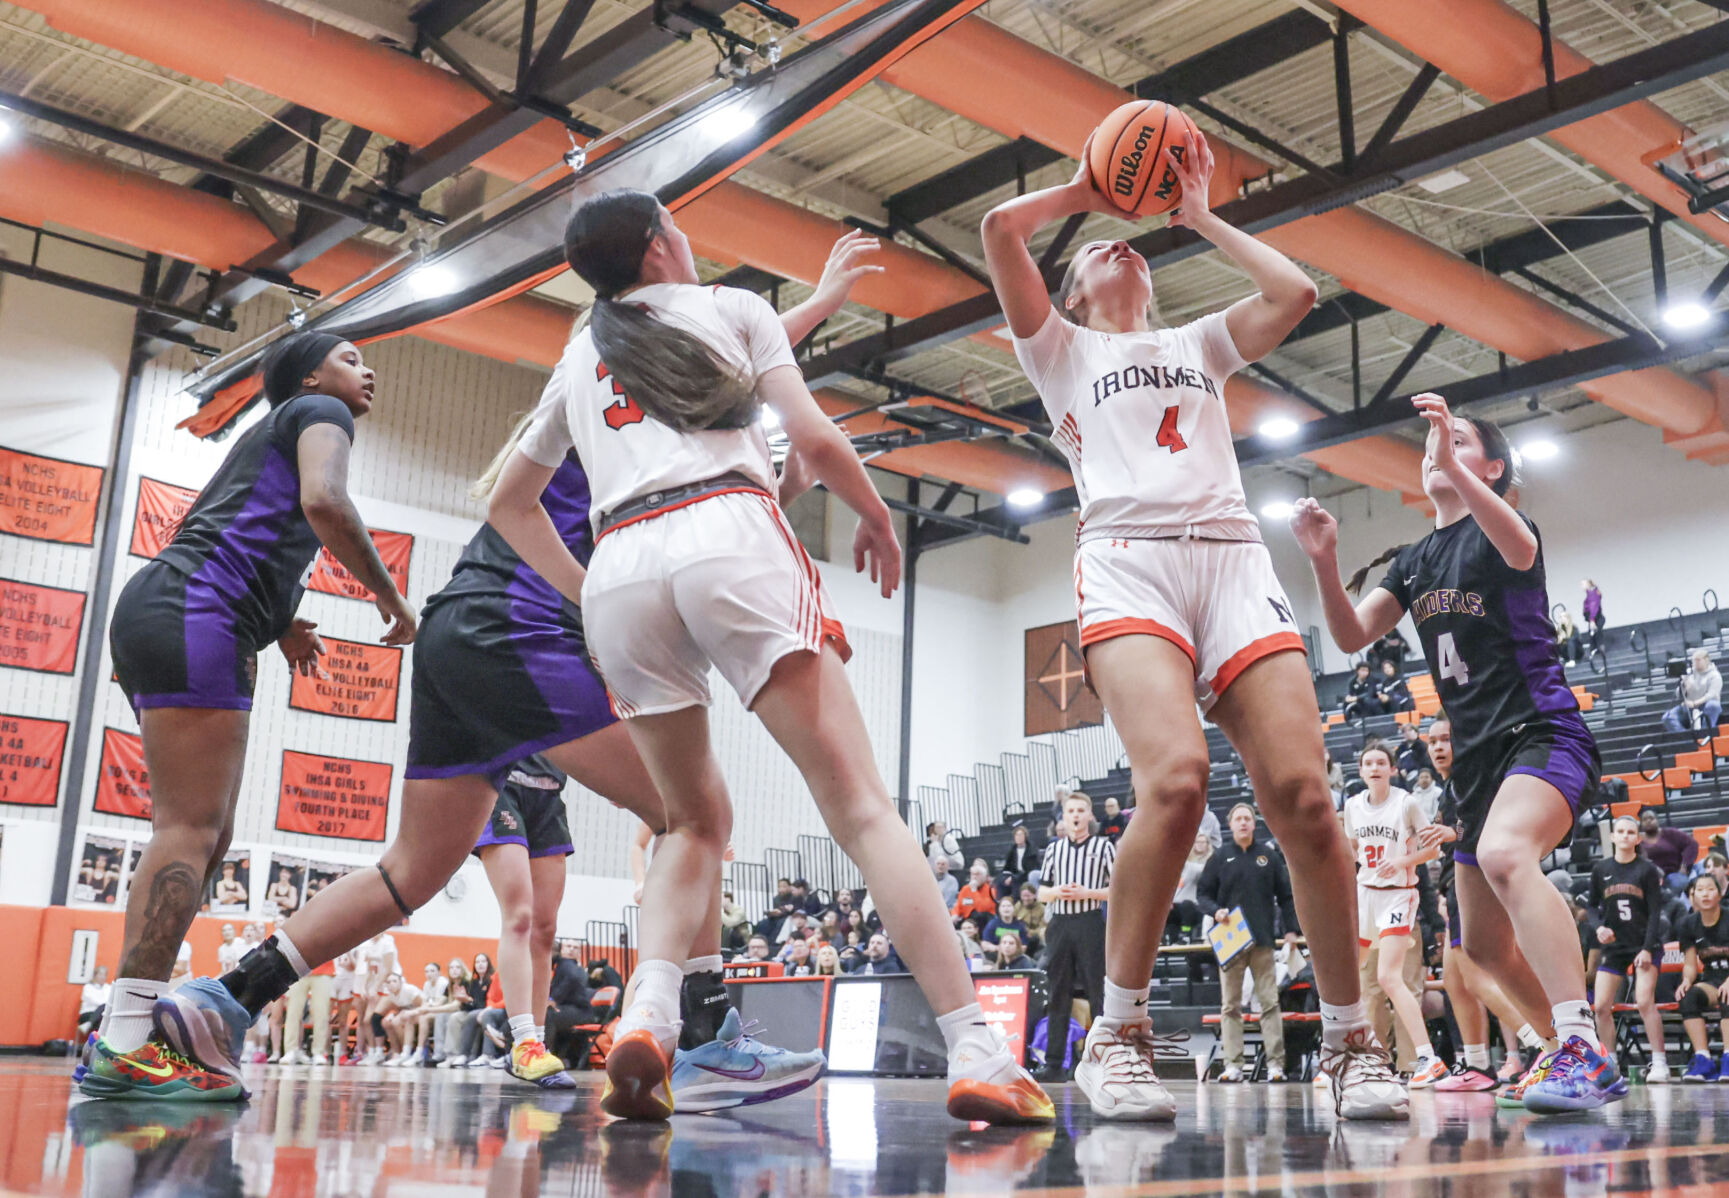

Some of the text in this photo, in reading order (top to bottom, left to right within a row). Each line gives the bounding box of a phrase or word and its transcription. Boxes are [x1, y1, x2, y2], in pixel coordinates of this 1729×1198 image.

[1115, 126, 1155, 196] Wilson
[1154, 145, 1185, 200] NCA
[1093, 365, 1218, 407] IRONMEN
[1156, 405, 1187, 454] 4
[23, 463, 56, 479] NCHS
[17, 480, 91, 503] VOLLEYBALL
[36, 502, 72, 517] EIGHT
[15, 515, 48, 531] 2004
[3, 589, 37, 605] NCHS
[1267, 596, 1296, 627] N
[16, 628, 52, 644] EIGHT
[336, 643, 364, 657] NCHS
[1437, 631, 1469, 686] 4
[328, 657, 370, 672] IHSA 4A
[333, 672, 394, 689] VOLLEYBALL
[316, 683, 376, 702] ELITE EIGHT
[324, 762, 352, 775] NCHS
[306, 773, 366, 791] IHSA GIRLS
[285, 784, 337, 803] SWIMMING
[351, 793, 385, 807] DIVING
[294, 801, 370, 820] FOURTH PLACE
[317, 820, 346, 834] 2017
[1390, 913, 1402, 924] N
[1617, 899, 1631, 921] 5
